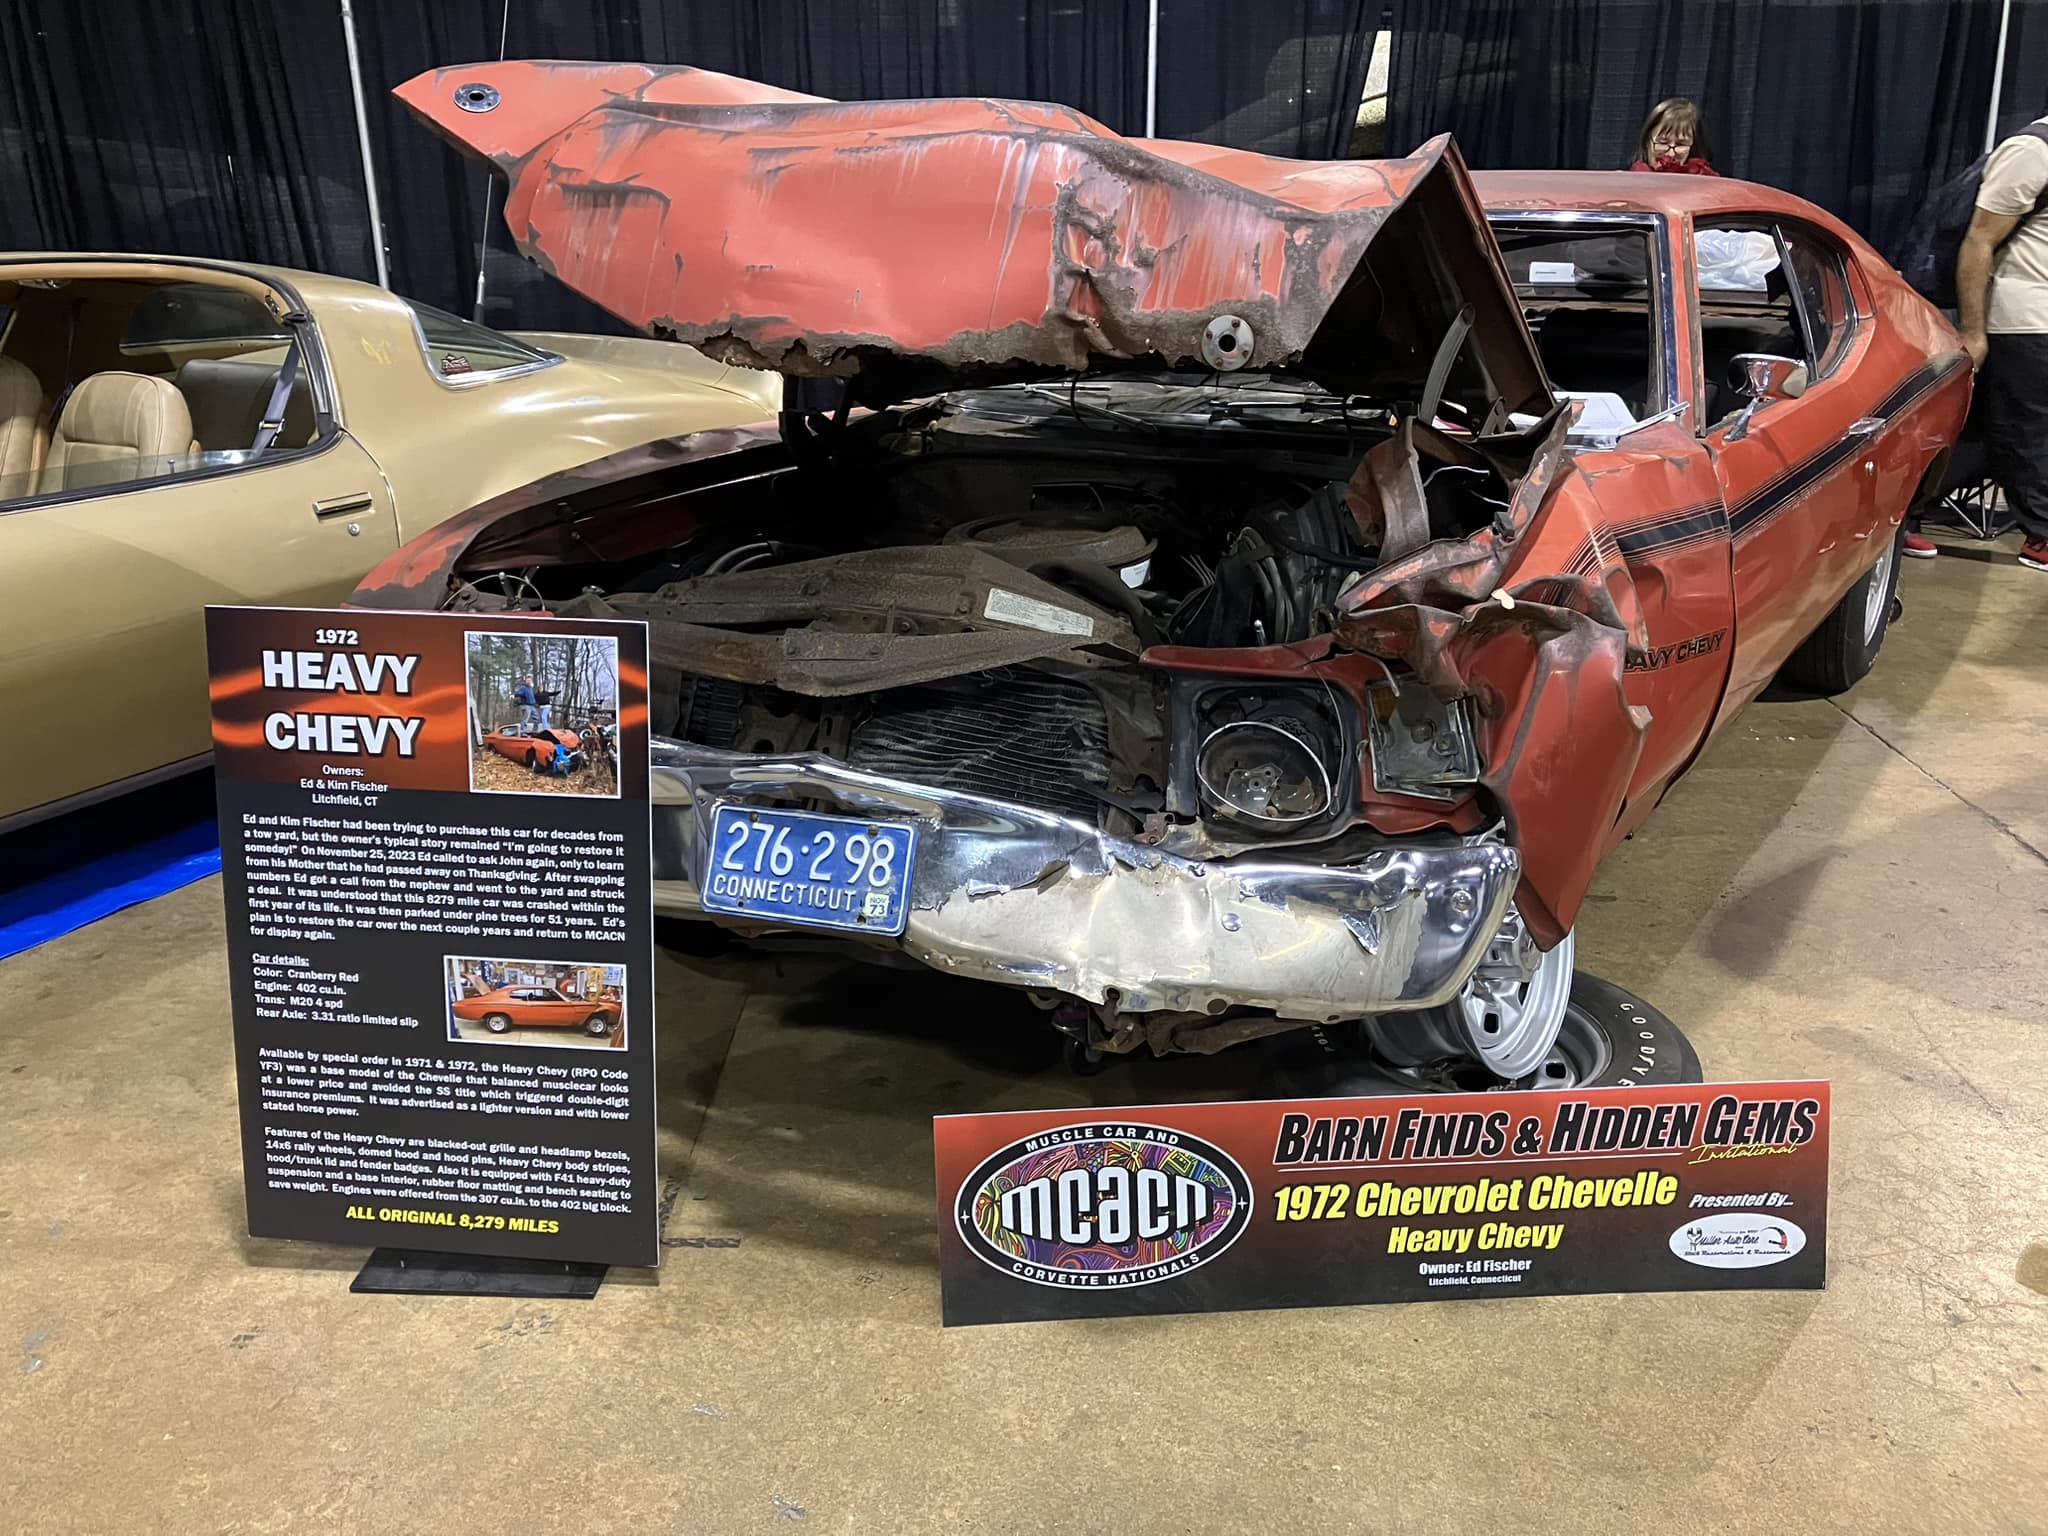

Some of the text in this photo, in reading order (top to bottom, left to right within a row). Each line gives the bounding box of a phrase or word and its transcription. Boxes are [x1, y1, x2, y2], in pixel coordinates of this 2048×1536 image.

[316, 629, 358, 645] 1972
[1677, 629, 1727, 662] CHEVY
[262, 650, 417, 693] HEAVY
[265, 712, 421, 755] CHEVY
[322, 764, 364, 777] Owners:
[300, 778, 389, 793] Ed & Kim Fischer
[311, 793, 379, 807] Litchfield, CT
[242, 813, 624, 842] Ed and Kim Fischer had been trying to purchase this car for decades from
[247, 884, 625, 914] a deal. It was understood that this 8279 mile car was crashed within the
[712, 873, 857, 913] CONNECTICUT
[869, 896, 887, 904] NOV
[869, 904, 887, 916] 73
[250, 925, 336, 941] for display again.
[252, 952, 310, 965] Car details:
[253, 966, 360, 983] Color: Cranberry Red
[254, 980, 347, 996] Engine: 402 cu.in.
[254, 993, 344, 1010] Trans: M20 4 spd
[256, 1007, 419, 1029] Rear Axle: 3.31 ratio limited slip
[258, 1047, 629, 1080] Available by special order in 1971 & 1972, the Heavy Chevy (RPO Code
[259, 1060, 630, 1094] YF3) was a base model of the Chevelle that balanced musclecar looks
[262, 1100, 360, 1117] stated horse power.
[1025, 1126, 1180, 1153] MUSCLE CAR AND
[1273, 1095, 1821, 1165] BARN FINDS & HIDDEN GEMS
[264, 1126, 631, 1162] Features of the Heavy Chevy are blacked-out grille and headlamp bezels,
[265, 1139, 631, 1175] 14x6 rally wheels, domed hood and hood pins, Heavy Chevy body stripes,
[1688, 1136, 1800, 1165] Invitational
[1274, 1171, 1679, 1222] 1972 Chevrolet Chevelle
[1688, 1193, 1766, 1209] Presented
[345, 1206, 559, 1234] ALL ORIGINAL 8,279 MILES
[1387, 1222, 1565, 1255] Heavy Chevy
[1012, 1253, 1201, 1286] CORVETTE NATIONALS
[1419, 1259, 1533, 1276] Owner: Ed Fischer
[1429, 1274, 1522, 1287] Litchfield, Connecticut
